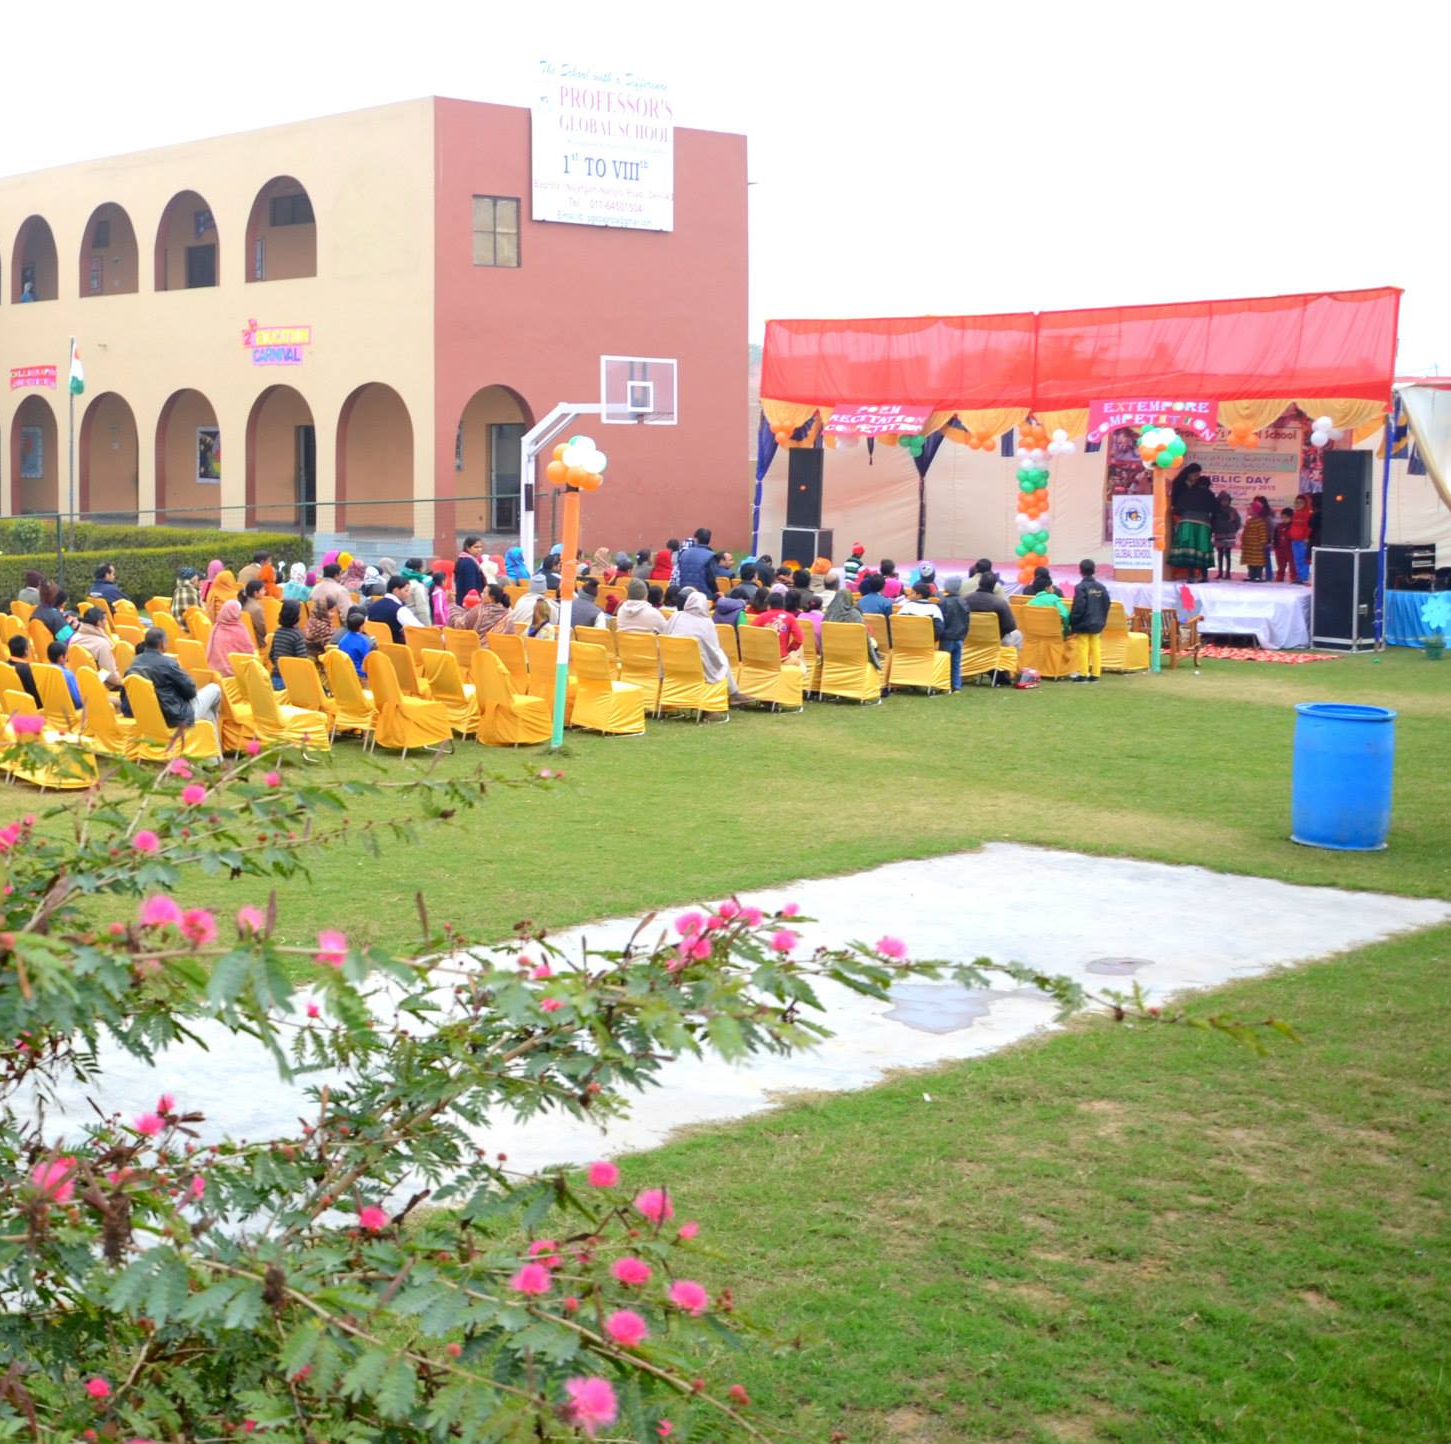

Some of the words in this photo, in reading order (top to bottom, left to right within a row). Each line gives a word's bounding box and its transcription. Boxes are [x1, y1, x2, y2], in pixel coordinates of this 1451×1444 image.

[559, 85, 674, 120] PROFESSOR'S
[559, 114, 611, 136] GLOBAL
[618, 122, 668, 143] SCHOOL
[584, 156, 607, 178] TO
[253, 348, 301, 362] CARNIVAL
[856, 405, 903, 414] POEM
[1103, 400, 1210, 413] EXTEMPORE
[829, 414, 927, 424] RECITATION
[1088, 413, 1215, 441] COMPETITION
[1265, 430, 1297, 440] School
[1246, 475, 1271, 484] DAY
